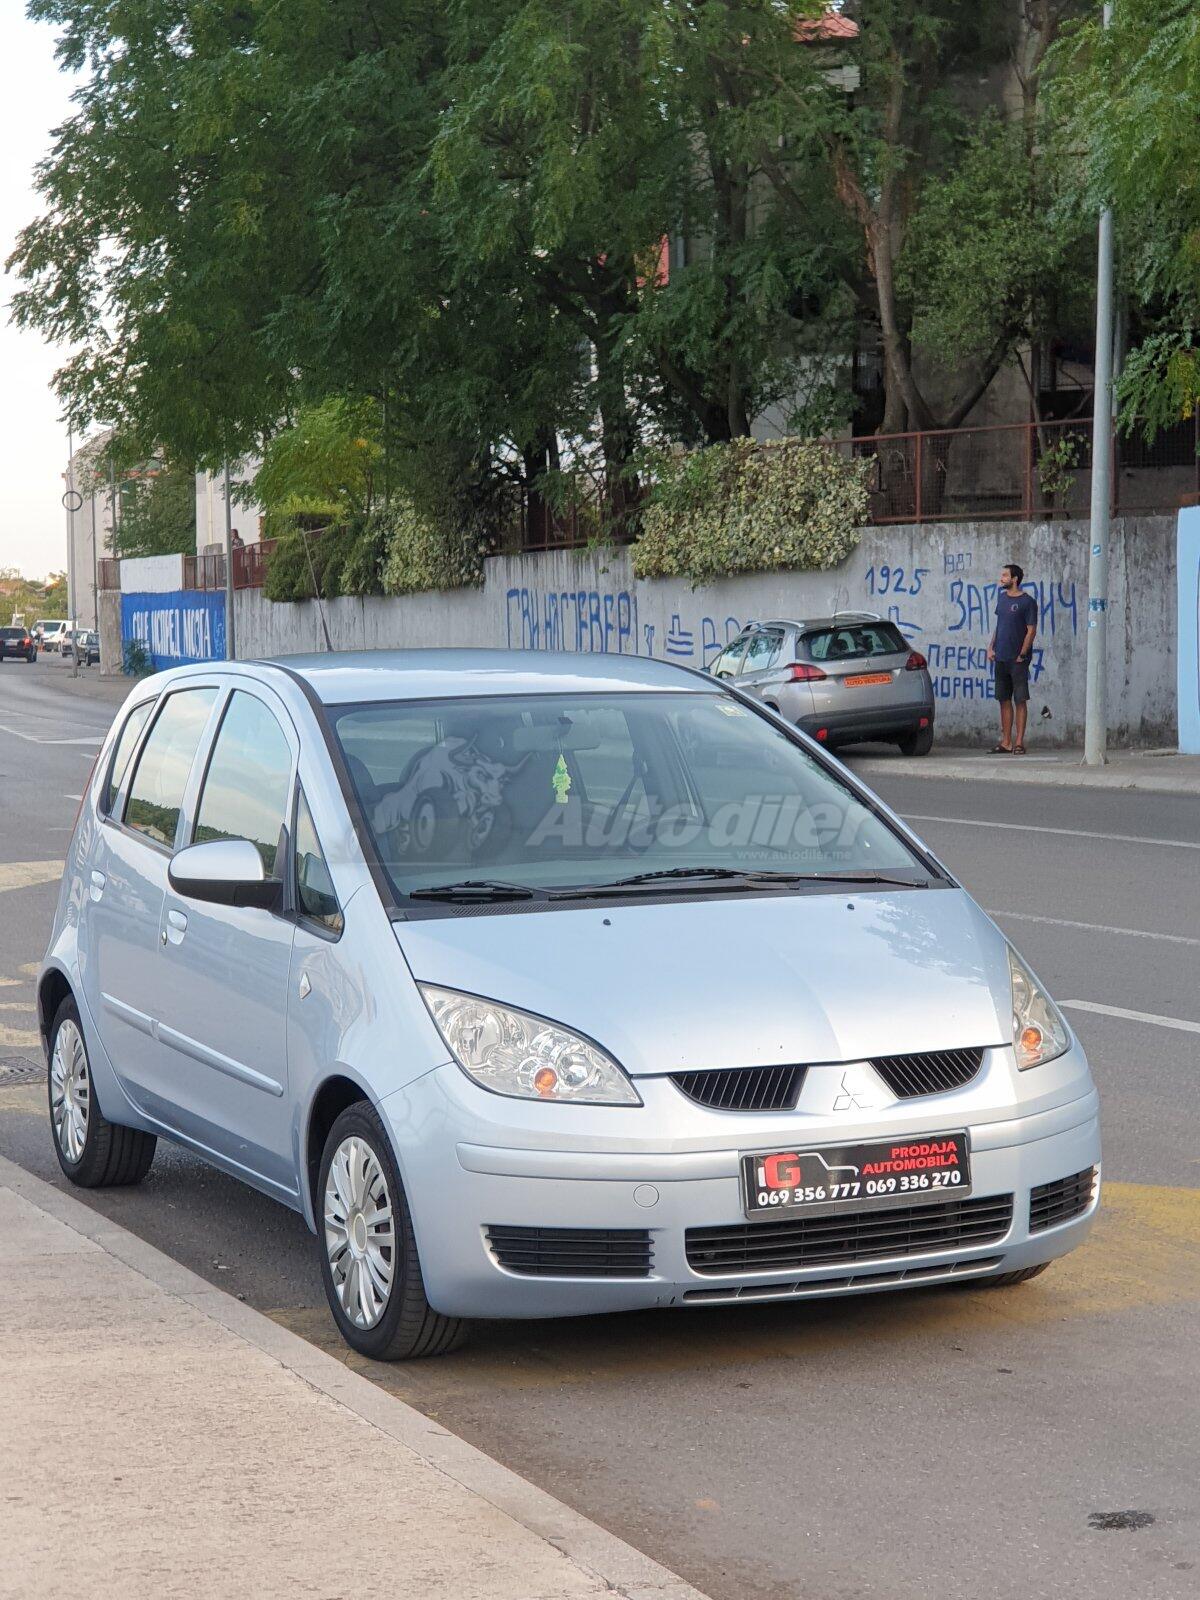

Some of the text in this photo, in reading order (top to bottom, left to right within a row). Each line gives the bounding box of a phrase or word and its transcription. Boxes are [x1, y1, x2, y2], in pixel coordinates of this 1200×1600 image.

[864, 566, 930, 597] 1925
[890, 1141, 957, 1159] PRODAJA
[862, 1153, 959, 1175] AUTOMOBILA
[757, 1169, 961, 1207] 069 356 777 069 336 270
